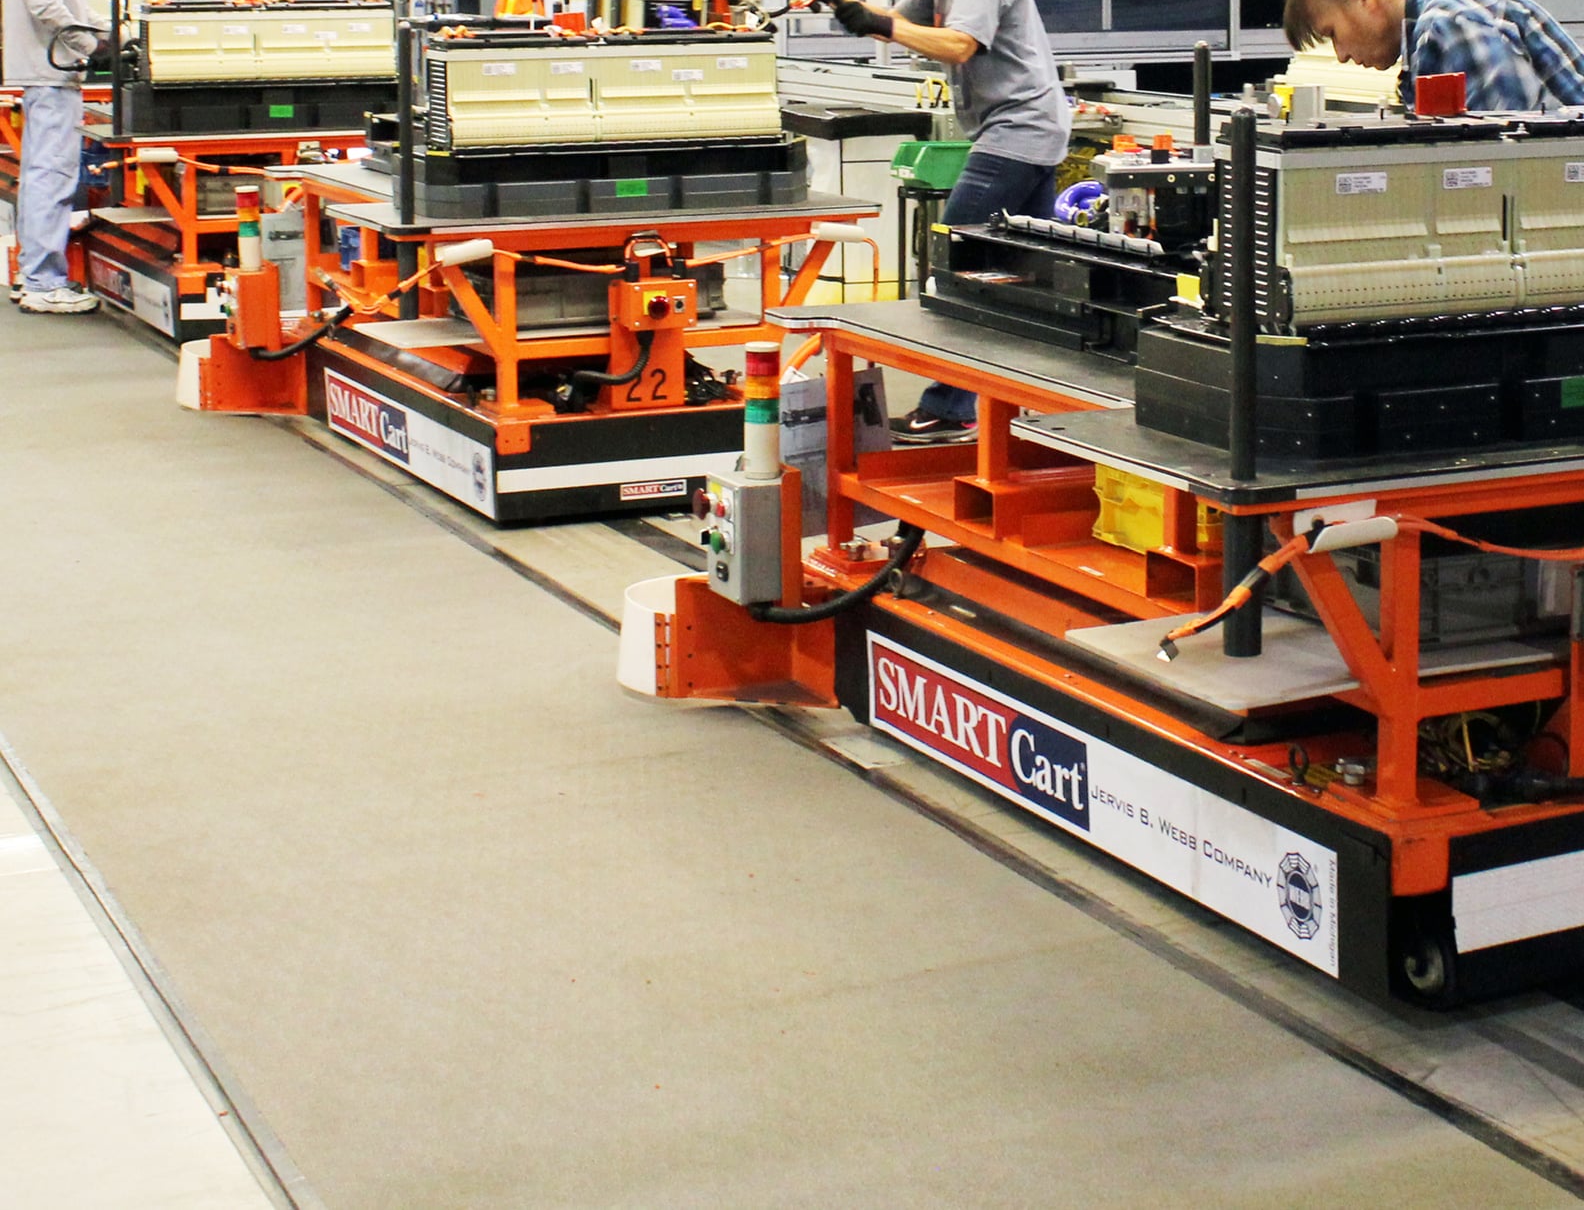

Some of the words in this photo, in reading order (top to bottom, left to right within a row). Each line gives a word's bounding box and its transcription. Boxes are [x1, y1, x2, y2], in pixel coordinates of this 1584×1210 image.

[626, 369, 667, 402] 22
[328, 383, 380, 438] SMART
[379, 410, 408, 455] Cart
[623, 485, 659, 496] SMART
[877, 656, 1007, 768] SMART
[1010, 727, 1085, 812] Cart
[1091, 785, 1135, 818] JERVIS
[1140, 808, 1154, 829] B.
[1158, 816, 1197, 851] WEBB
[1203, 840, 1273, 889] COMPANY
[1328, 859, 1337, 894] Made
[1328, 911, 1337, 967] Michigan
